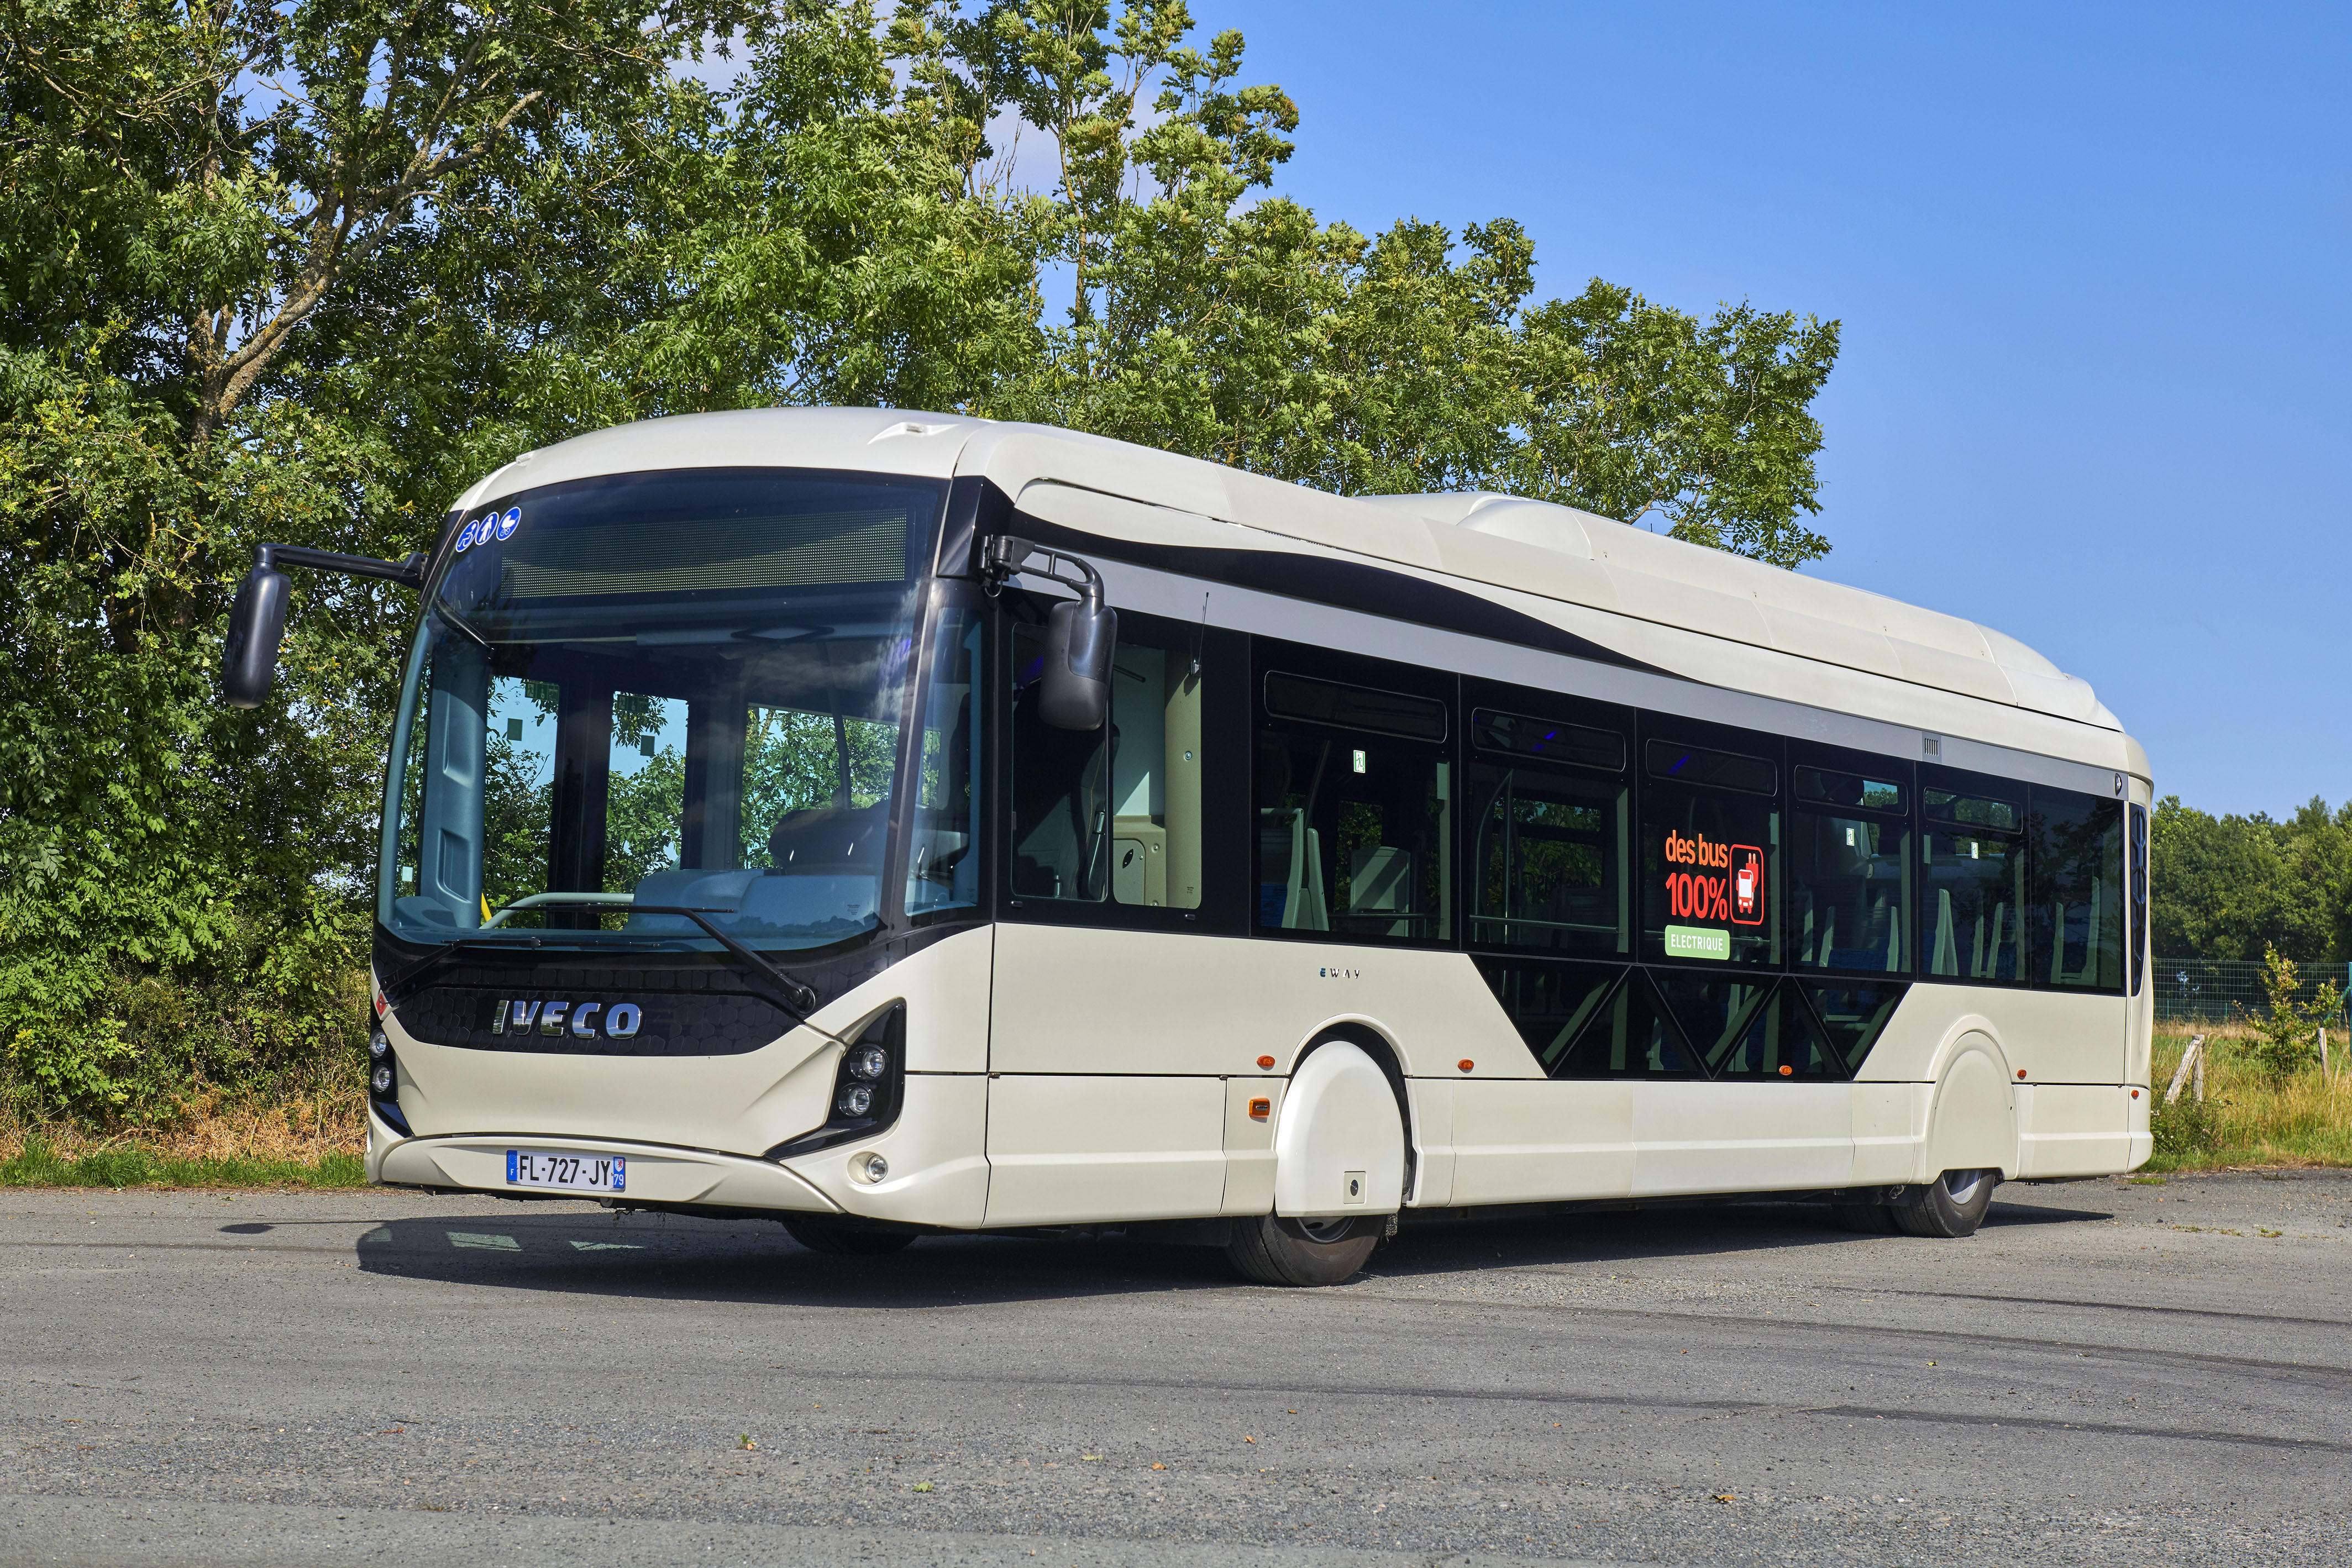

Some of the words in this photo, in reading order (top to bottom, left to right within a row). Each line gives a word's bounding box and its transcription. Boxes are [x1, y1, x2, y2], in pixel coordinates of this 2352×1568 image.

[1666, 829, 1696, 864] des
[1698, 833, 1728, 868] bus
[1665, 872, 1728, 920] 100%
[1671, 934, 1723, 951] ELECTRIQUE
[492, 999, 644, 1040] IVECO
[519, 1155, 611, 1186] FL-727-JY
[614, 1174, 624, 1186] 79
